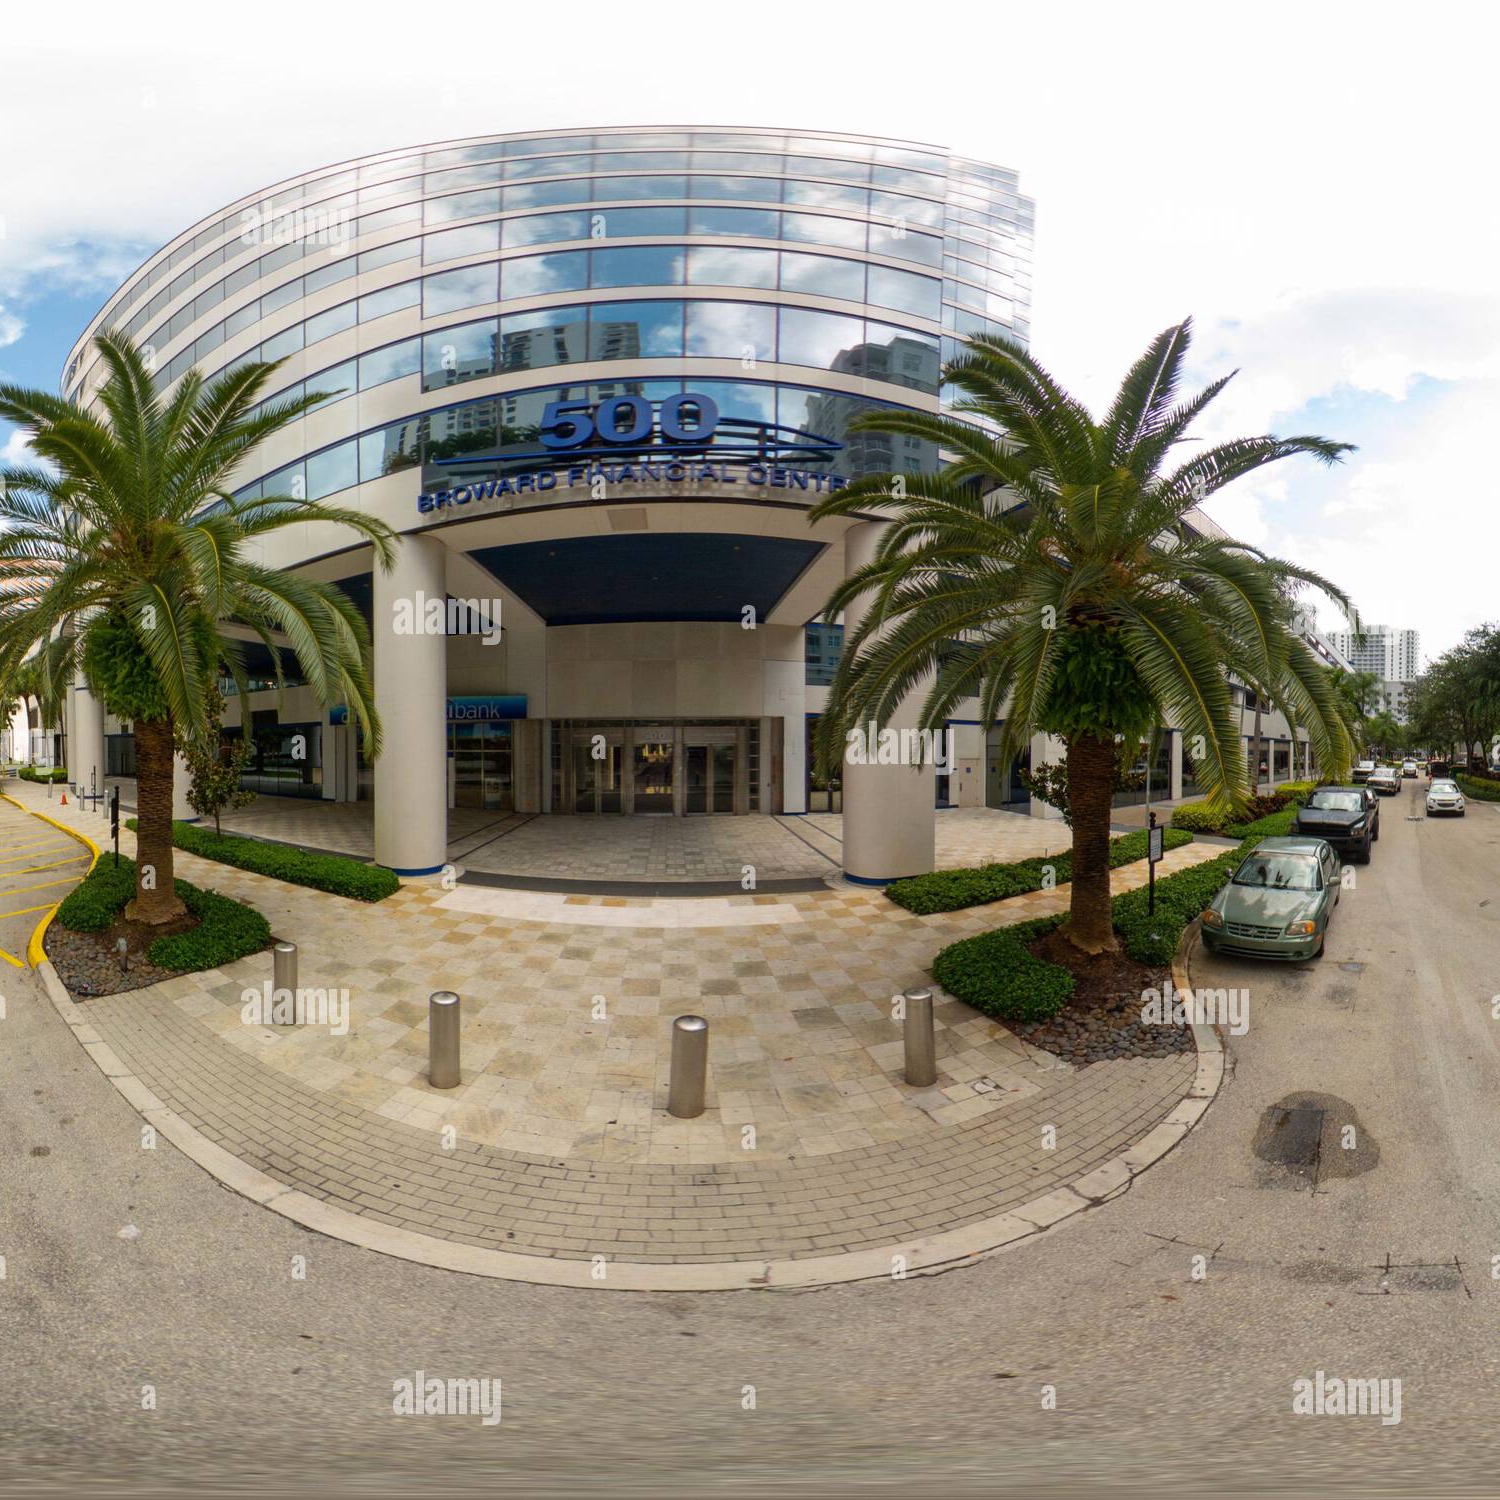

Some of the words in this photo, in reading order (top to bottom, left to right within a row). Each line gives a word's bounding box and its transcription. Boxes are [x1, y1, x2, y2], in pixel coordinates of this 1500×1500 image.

[539, 393, 719, 450] 500
[418, 469, 557, 513] BROWARD
[567, 462, 737, 487] FINANCIAL
[746, 464, 847, 495] CENTR
[446, 701, 501, 718] ibank
